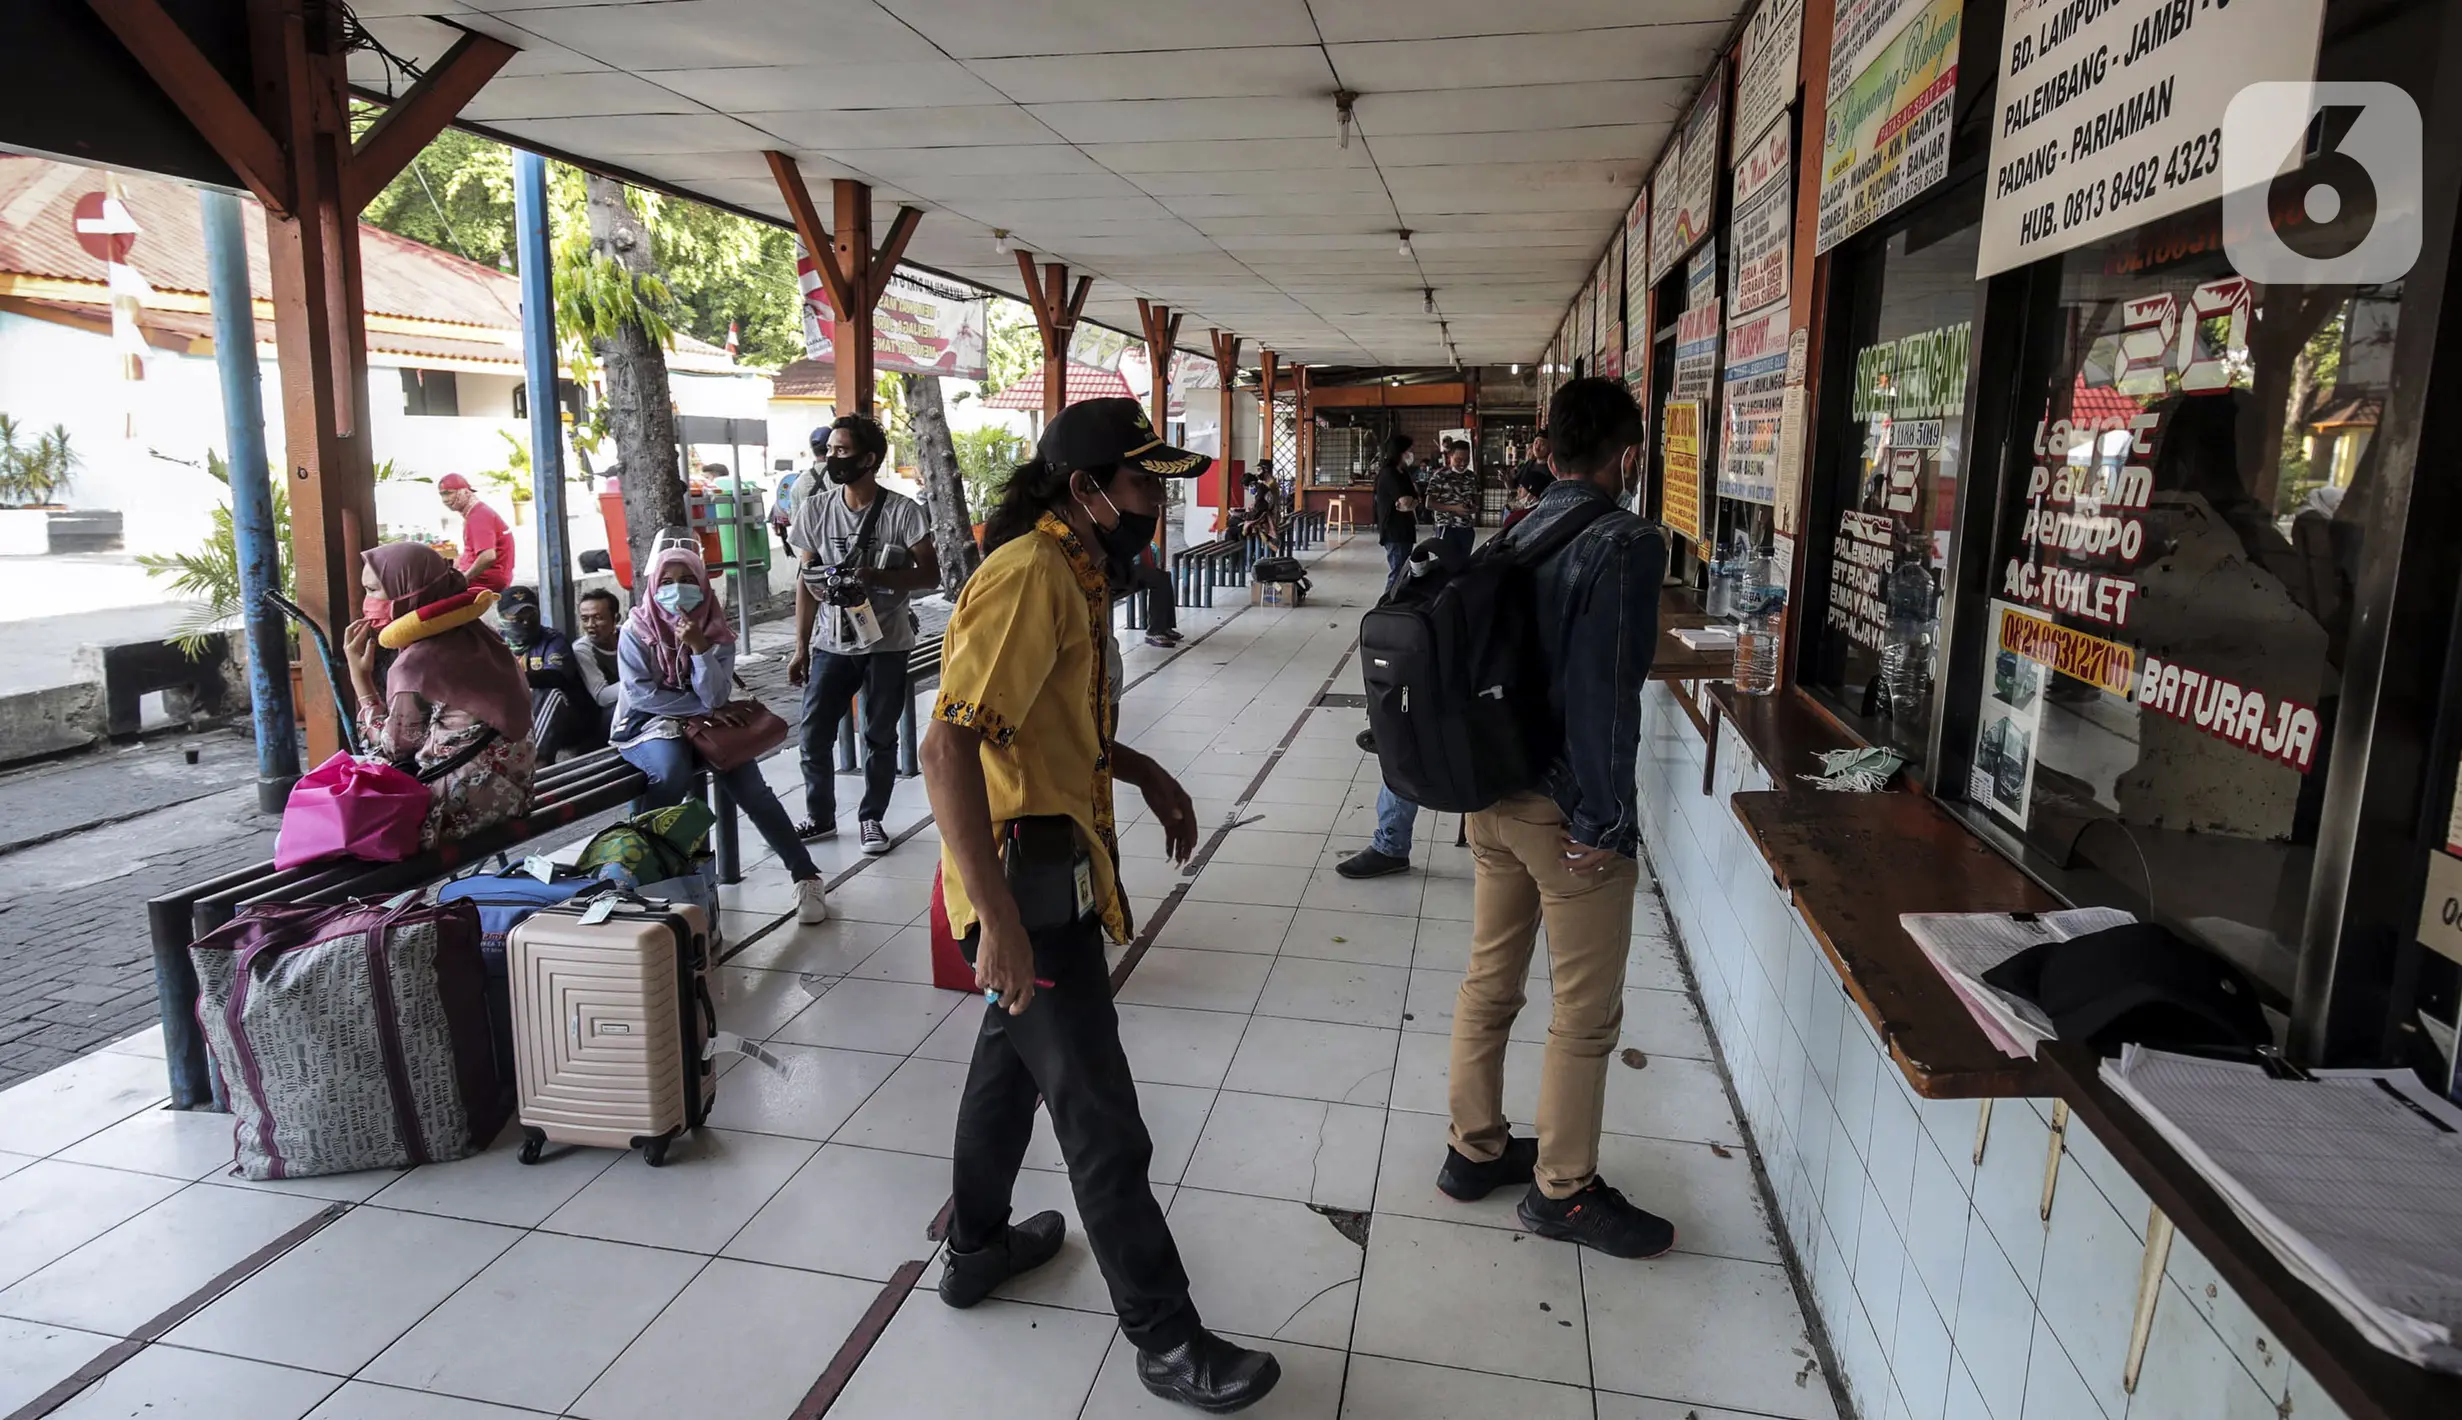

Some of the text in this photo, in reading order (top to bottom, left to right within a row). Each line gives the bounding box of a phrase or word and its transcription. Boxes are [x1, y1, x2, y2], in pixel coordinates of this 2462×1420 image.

[2003, 45, 2107, 139] PALEMBANG
[2124, 0, 2194, 67] JAMBI
[2010, 0, 2121, 77] BD. LAMPUN
[1820, 179, 1847, 212] CILACAP
[1851, 148, 1883, 190] WANGON
[1888, 134, 1903, 163] KW.
[1906, 93, 1951, 149] NGANTEN
[1880, 118, 1901, 140] PATAS
[1902, 109, 1914, 125] AC
[1914, 89, 1936, 115] SEAT
[1996, 140, 2057, 200] PADANG
[2070, 75, 2175, 164] PARIAMAN
[1820, 202, 1848, 236] SIDAREJA
[1867, 165, 1901, 205] PUCUNG
[1906, 132, 1945, 178] BANJAR
[1924, 161, 1943, 187] 8289
[2020, 201, 2057, 247] HUB.
[2063, 179, 2106, 230] 0813
[2110, 155, 2159, 212] 8492
[2163, 128, 2221, 189] 4323
[1896, 421, 1914, 446] 1188
[1916, 420, 1940, 446] 5019
[1831, 560, 1879, 598] BTRAJA
[1834, 536, 1894, 575] PALEMBANG
[2003, 613, 2131, 692] 082186312700
[2139, 657, 2320, 768] BATURAJA
